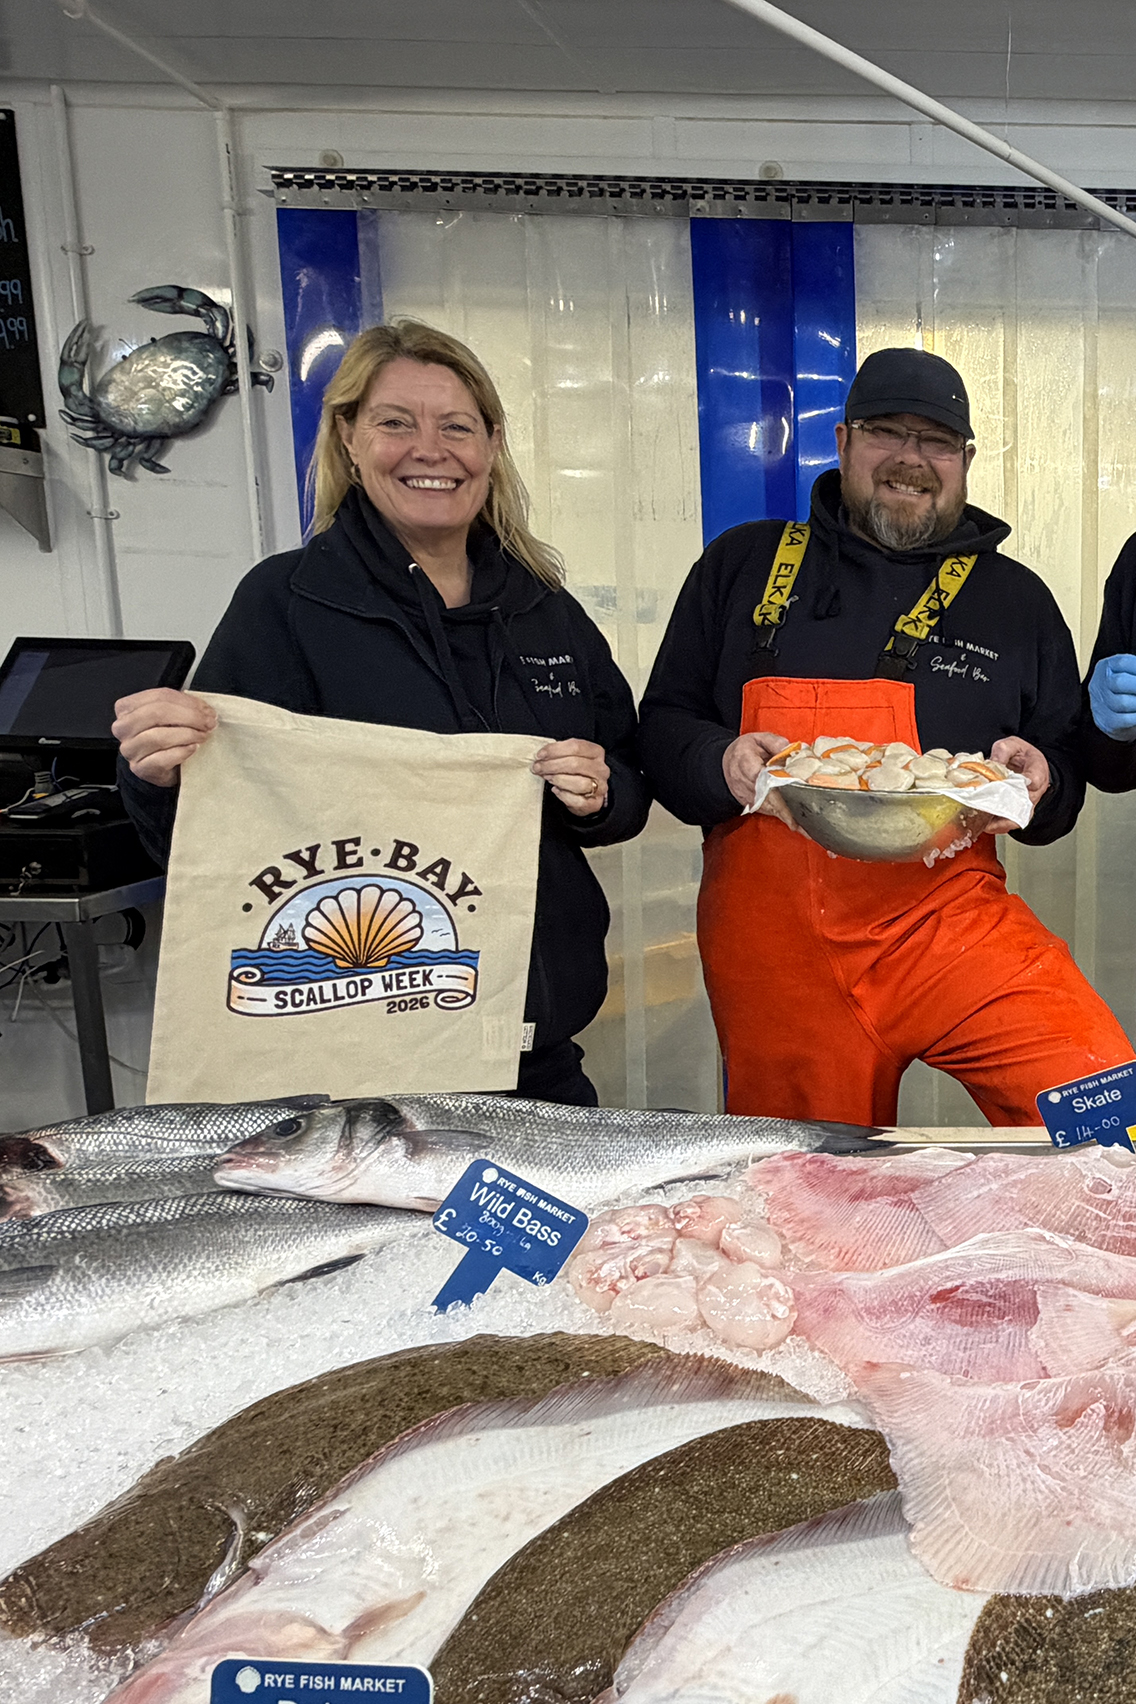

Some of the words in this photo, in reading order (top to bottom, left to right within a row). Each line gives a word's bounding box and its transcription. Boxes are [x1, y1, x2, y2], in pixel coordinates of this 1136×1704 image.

[966, 642, 999, 661] MARKET
[930, 656, 969, 678] Seafood
[273, 978, 374, 1009] SCALLOP
[383, 968, 434, 992] WEEK
[386, 996, 430, 1014] 2026
[1062, 1086, 1079, 1097] RYE
[1080, 1079, 1099, 1091] FISH
[1099, 1068, 1134, 1084] MARKET
[1072, 1089, 1122, 1113] Skate
[1055, 1131, 1070, 1148] £
[497, 1177, 517, 1193] RYE
[516, 1187, 539, 1204] FISH
[537, 1199, 577, 1225] MARKET
[470, 1182, 516, 1219] Wild
[512, 1207, 562, 1247] Bass
[434, 1208, 457, 1231] £
[532, 1271, 548, 1286] Kg
[264, 1674, 295, 1688] RYE
[299, 1675, 335, 1690] FISH
[340, 1677, 406, 1693] MARKET
